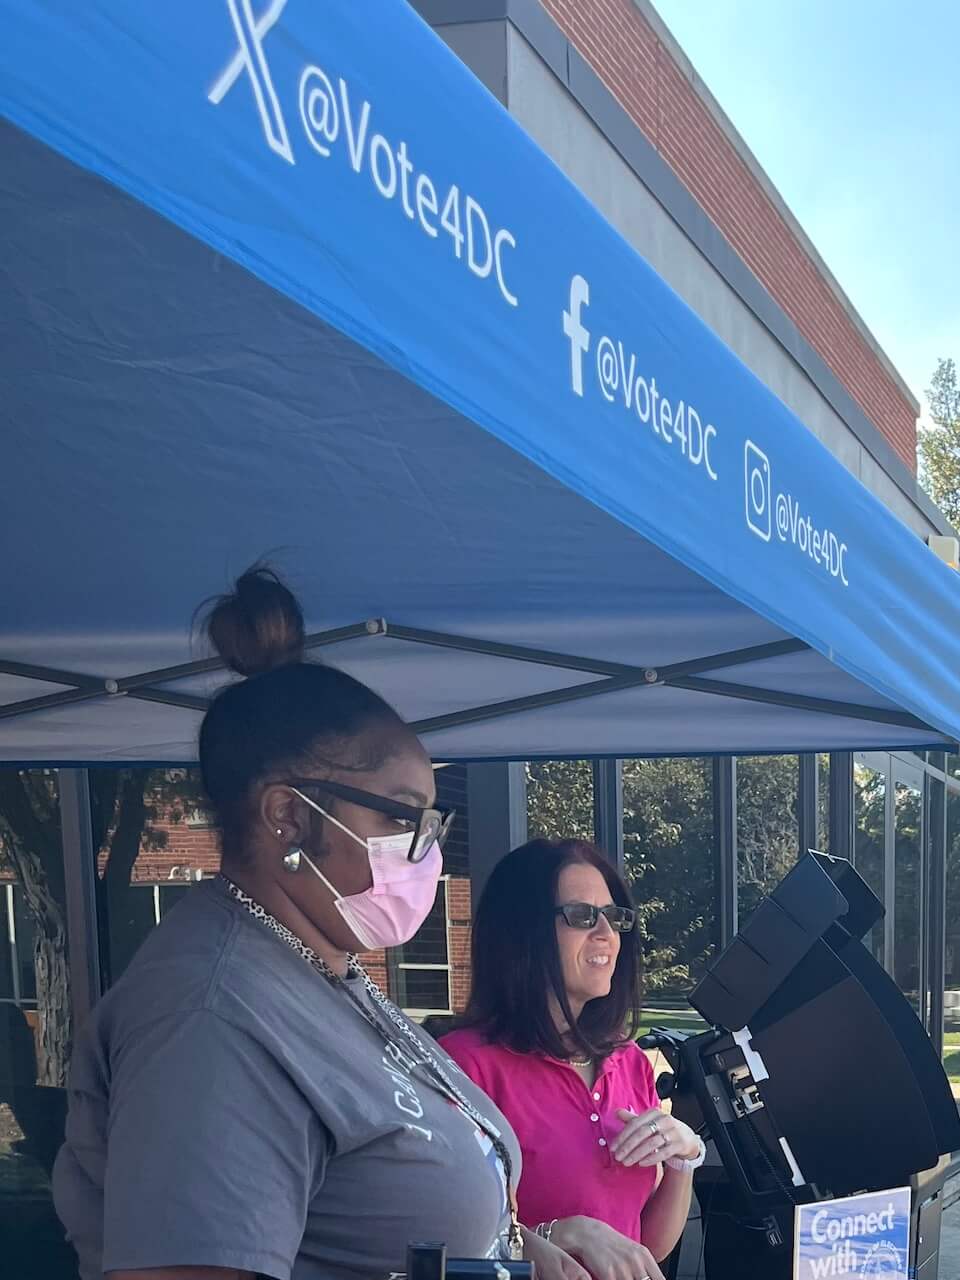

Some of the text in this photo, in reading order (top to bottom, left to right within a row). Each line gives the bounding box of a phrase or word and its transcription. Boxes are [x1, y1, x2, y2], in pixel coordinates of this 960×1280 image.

[299, 63, 519, 307] @Vote4DC
[596, 335, 718, 481] @Vote4DC
[774, 492, 849, 586] @Vote4DC
[809, 1239, 857, 1280] with
[811, 1202, 895, 1243] Connect
